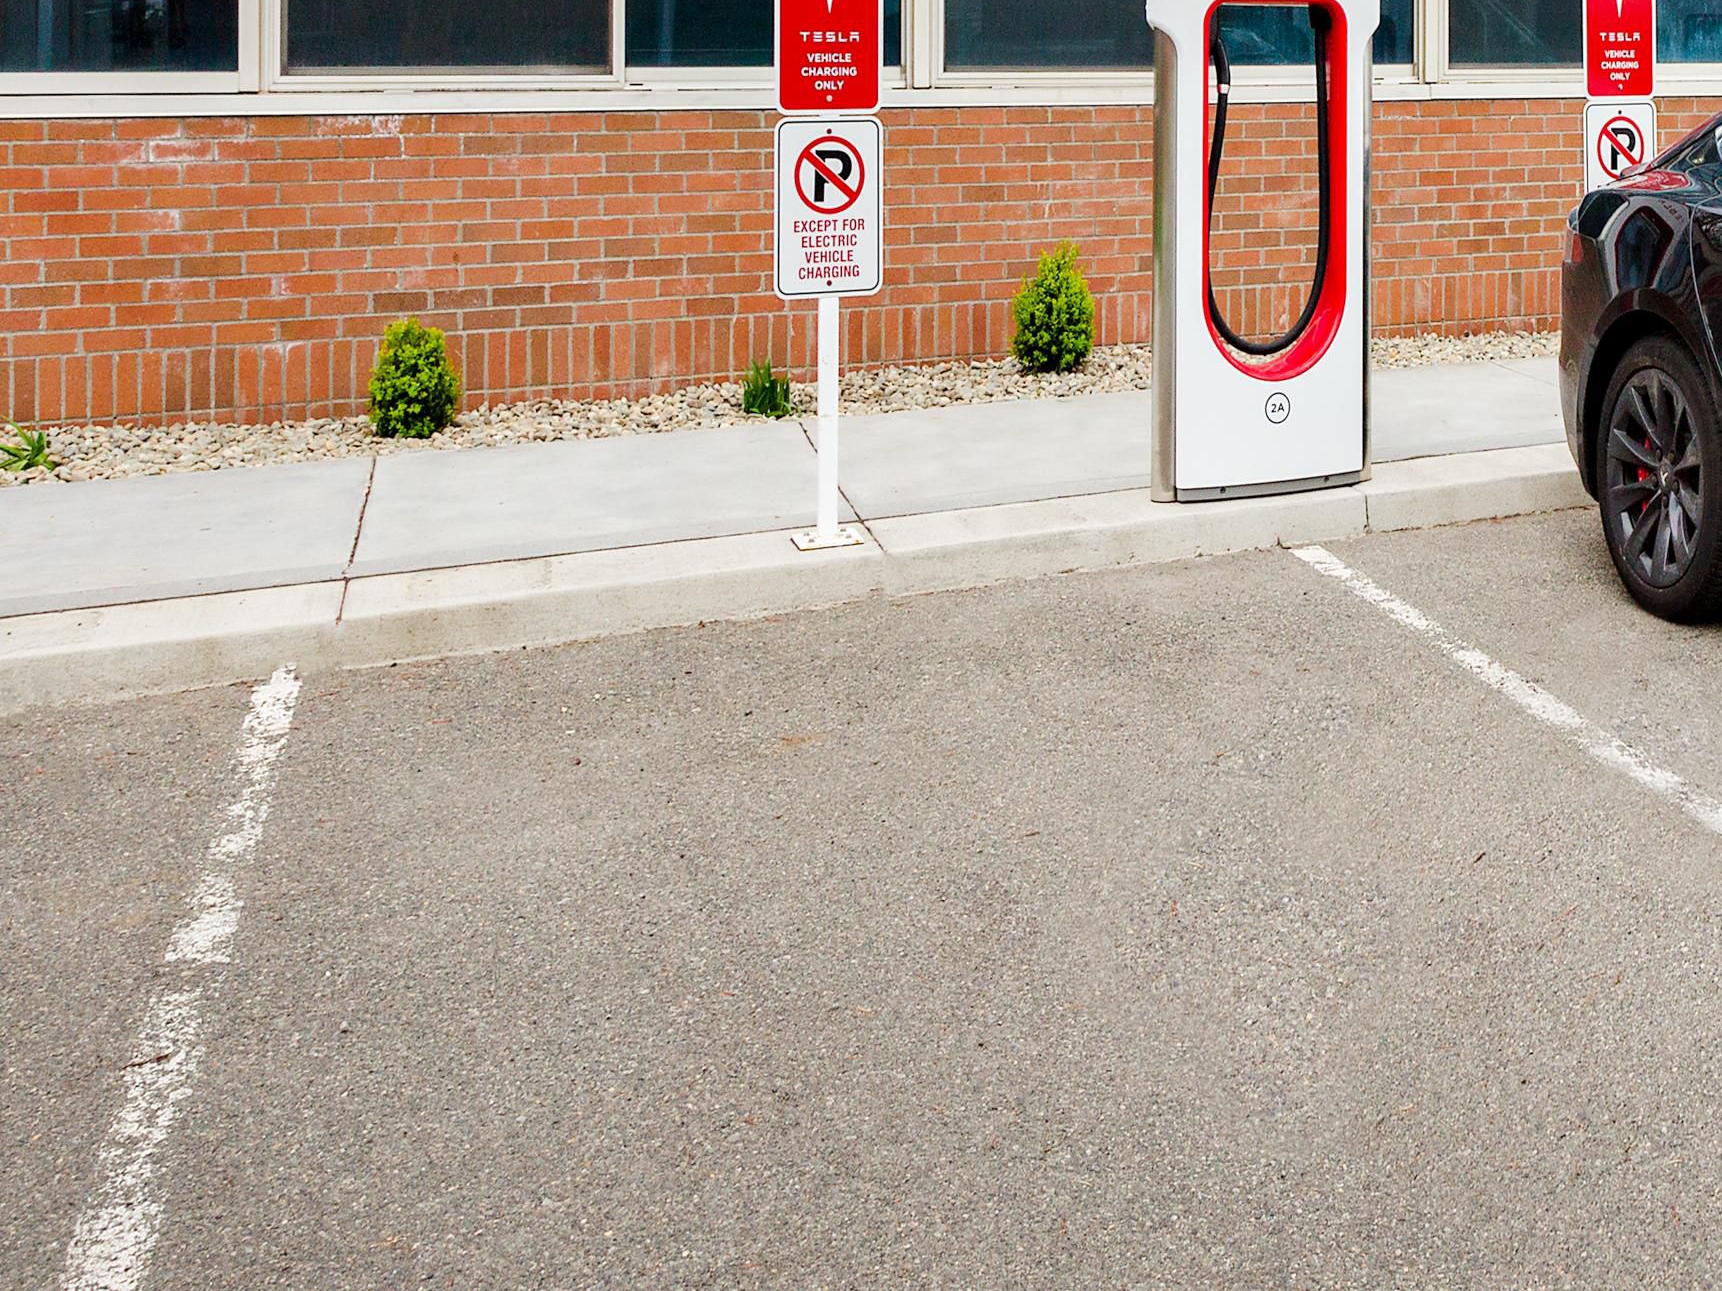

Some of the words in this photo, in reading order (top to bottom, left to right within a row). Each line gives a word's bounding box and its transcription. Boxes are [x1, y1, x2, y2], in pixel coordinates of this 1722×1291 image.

[800, 31, 860, 43] TESLA
[1600, 32, 1641, 42] TESLA
[807, 53, 852, 63] VEHICLE
[1604, 50, 1635, 59] VEHICLE
[1600, 61, 1639, 70] CHARGING
[801, 66, 857, 77] CHARGING
[1609, 71, 1631, 81] ONLY
[814, 80, 844, 90] ONLY
[793, 219, 838, 233] EXCEPT
[842, 218, 865, 231] FOR
[801, 234, 858, 248] ELECTRIC
[805, 249, 854, 263] VEHICLE
[798, 265, 860, 279] CHARGING
[1271, 402, 1285, 413] 2A
